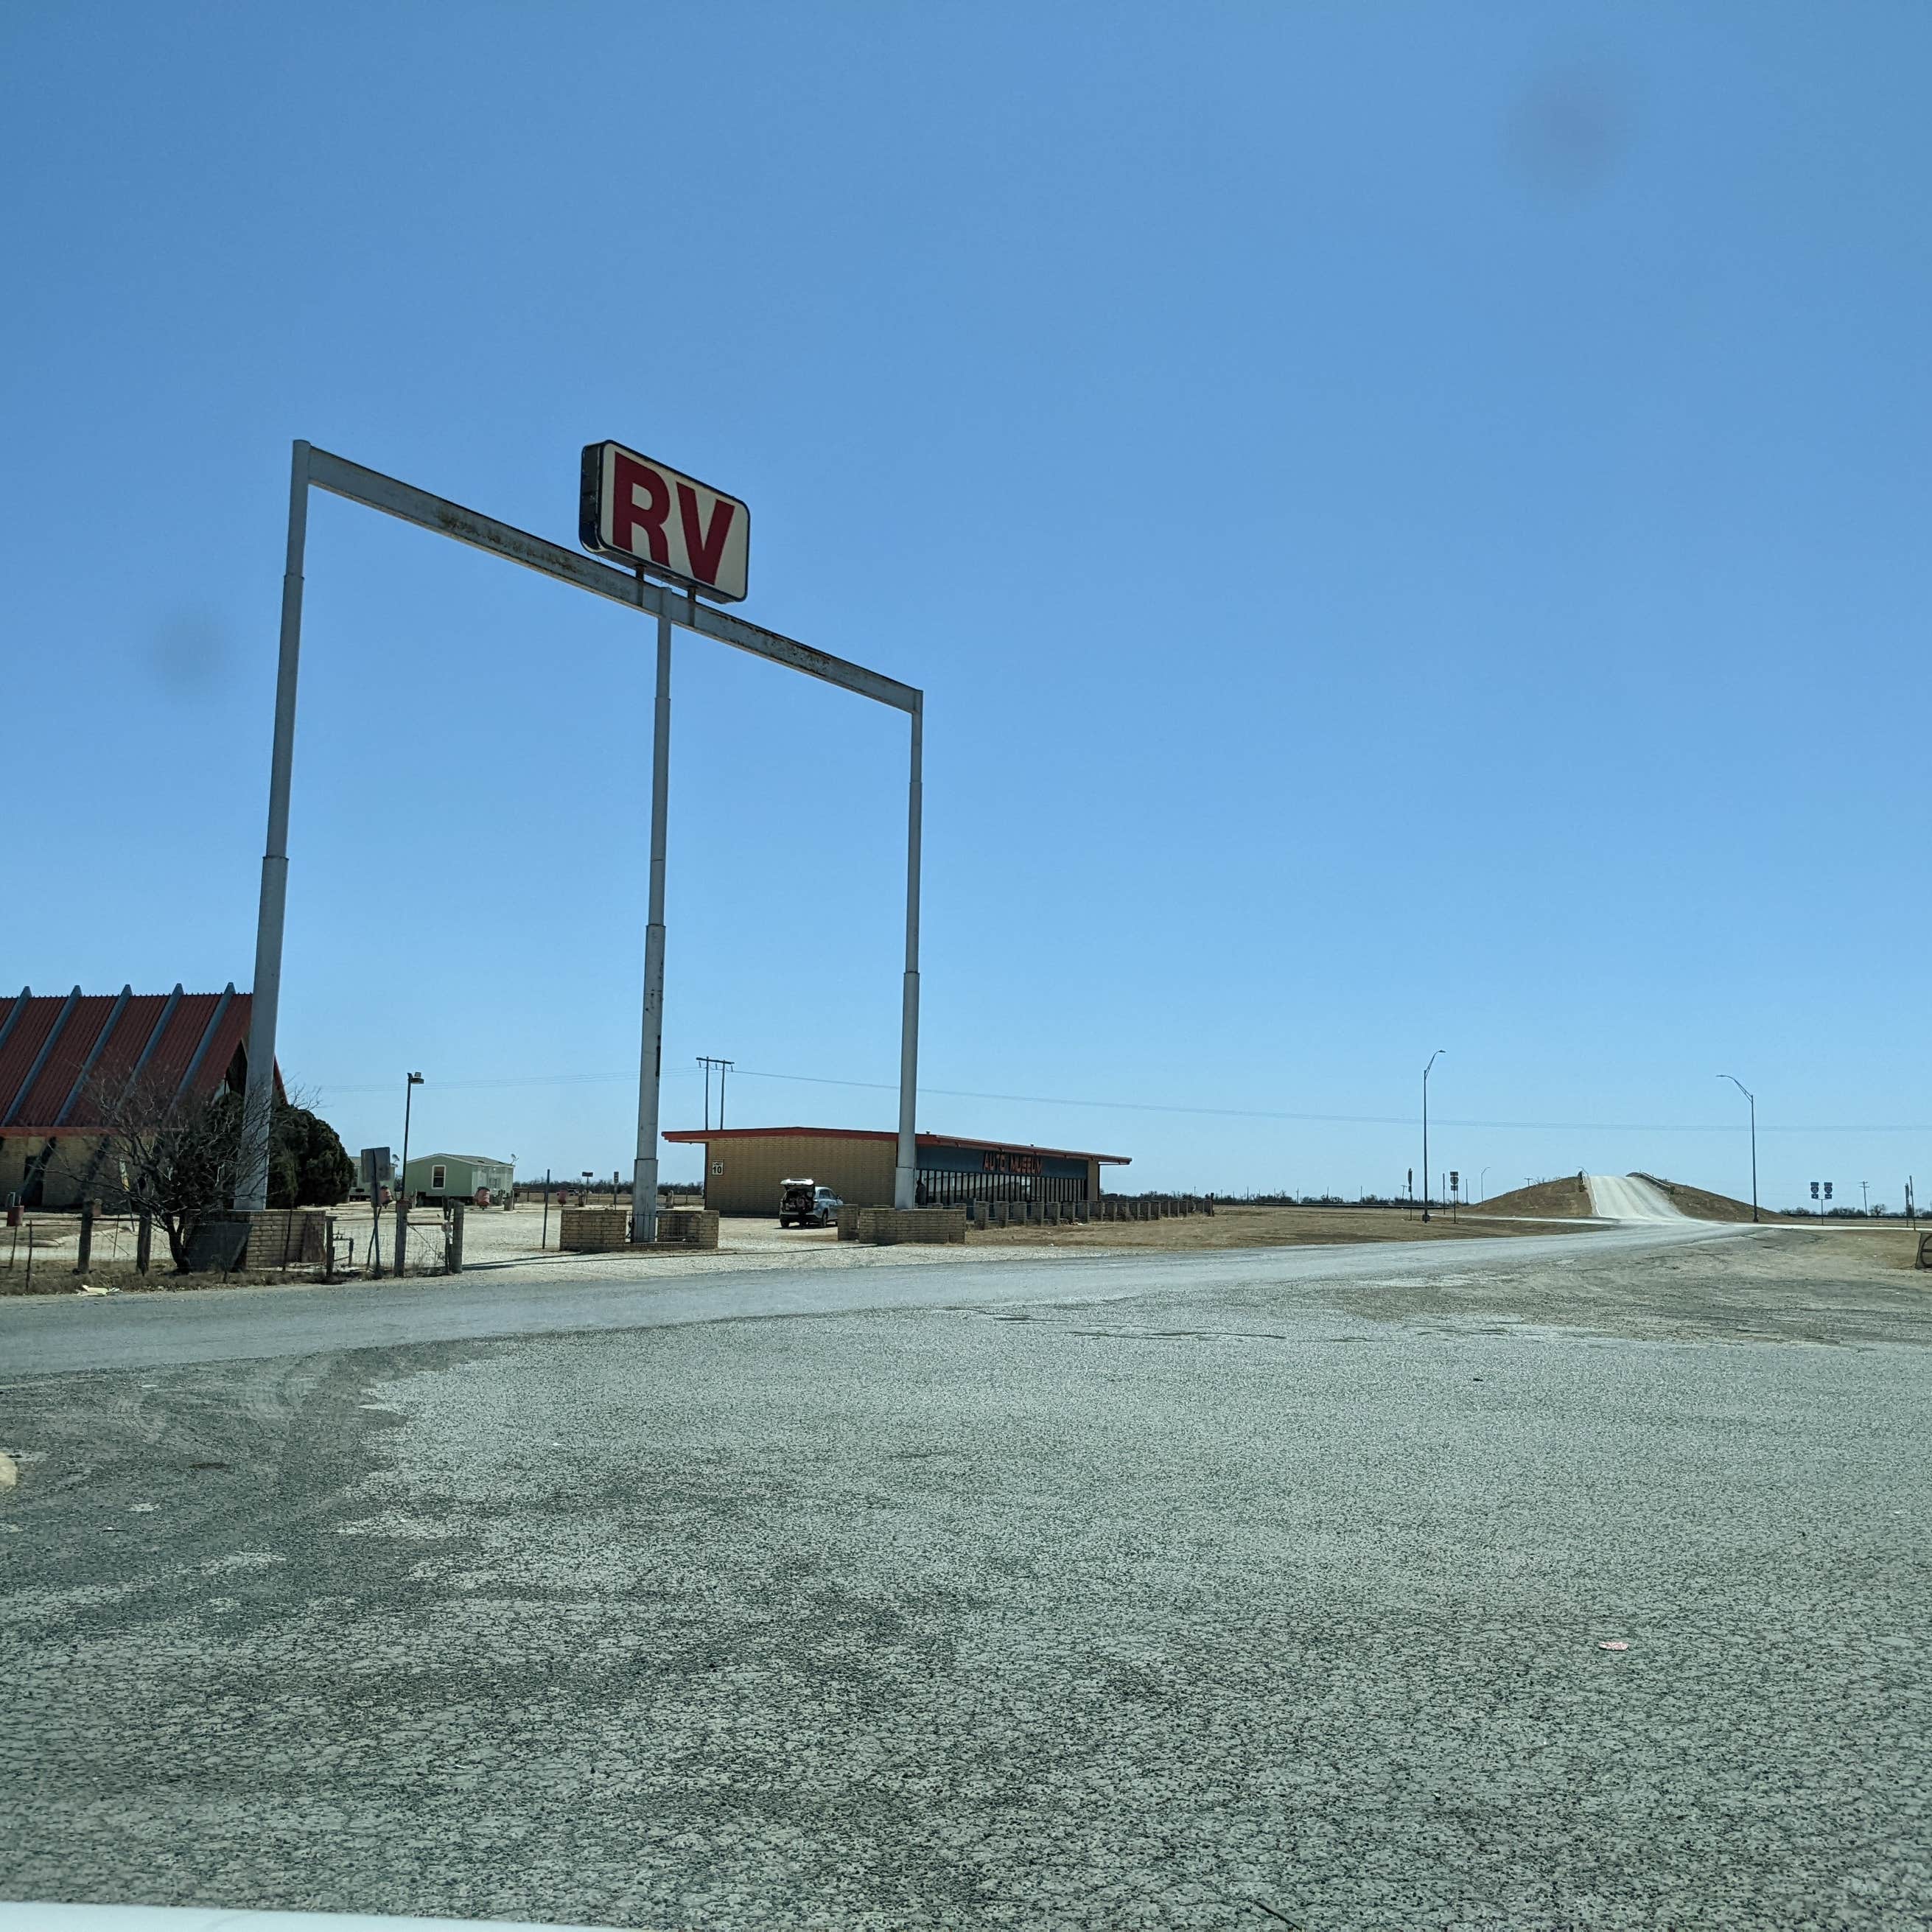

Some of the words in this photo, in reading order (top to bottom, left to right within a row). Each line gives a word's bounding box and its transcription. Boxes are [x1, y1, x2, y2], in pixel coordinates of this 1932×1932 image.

[612, 451, 735, 586] RV
[713, 1166, 722, 1174] 10
[984, 1152, 1006, 1172] AUTO
[1010, 1155, 1042, 1175] MUSEUM
